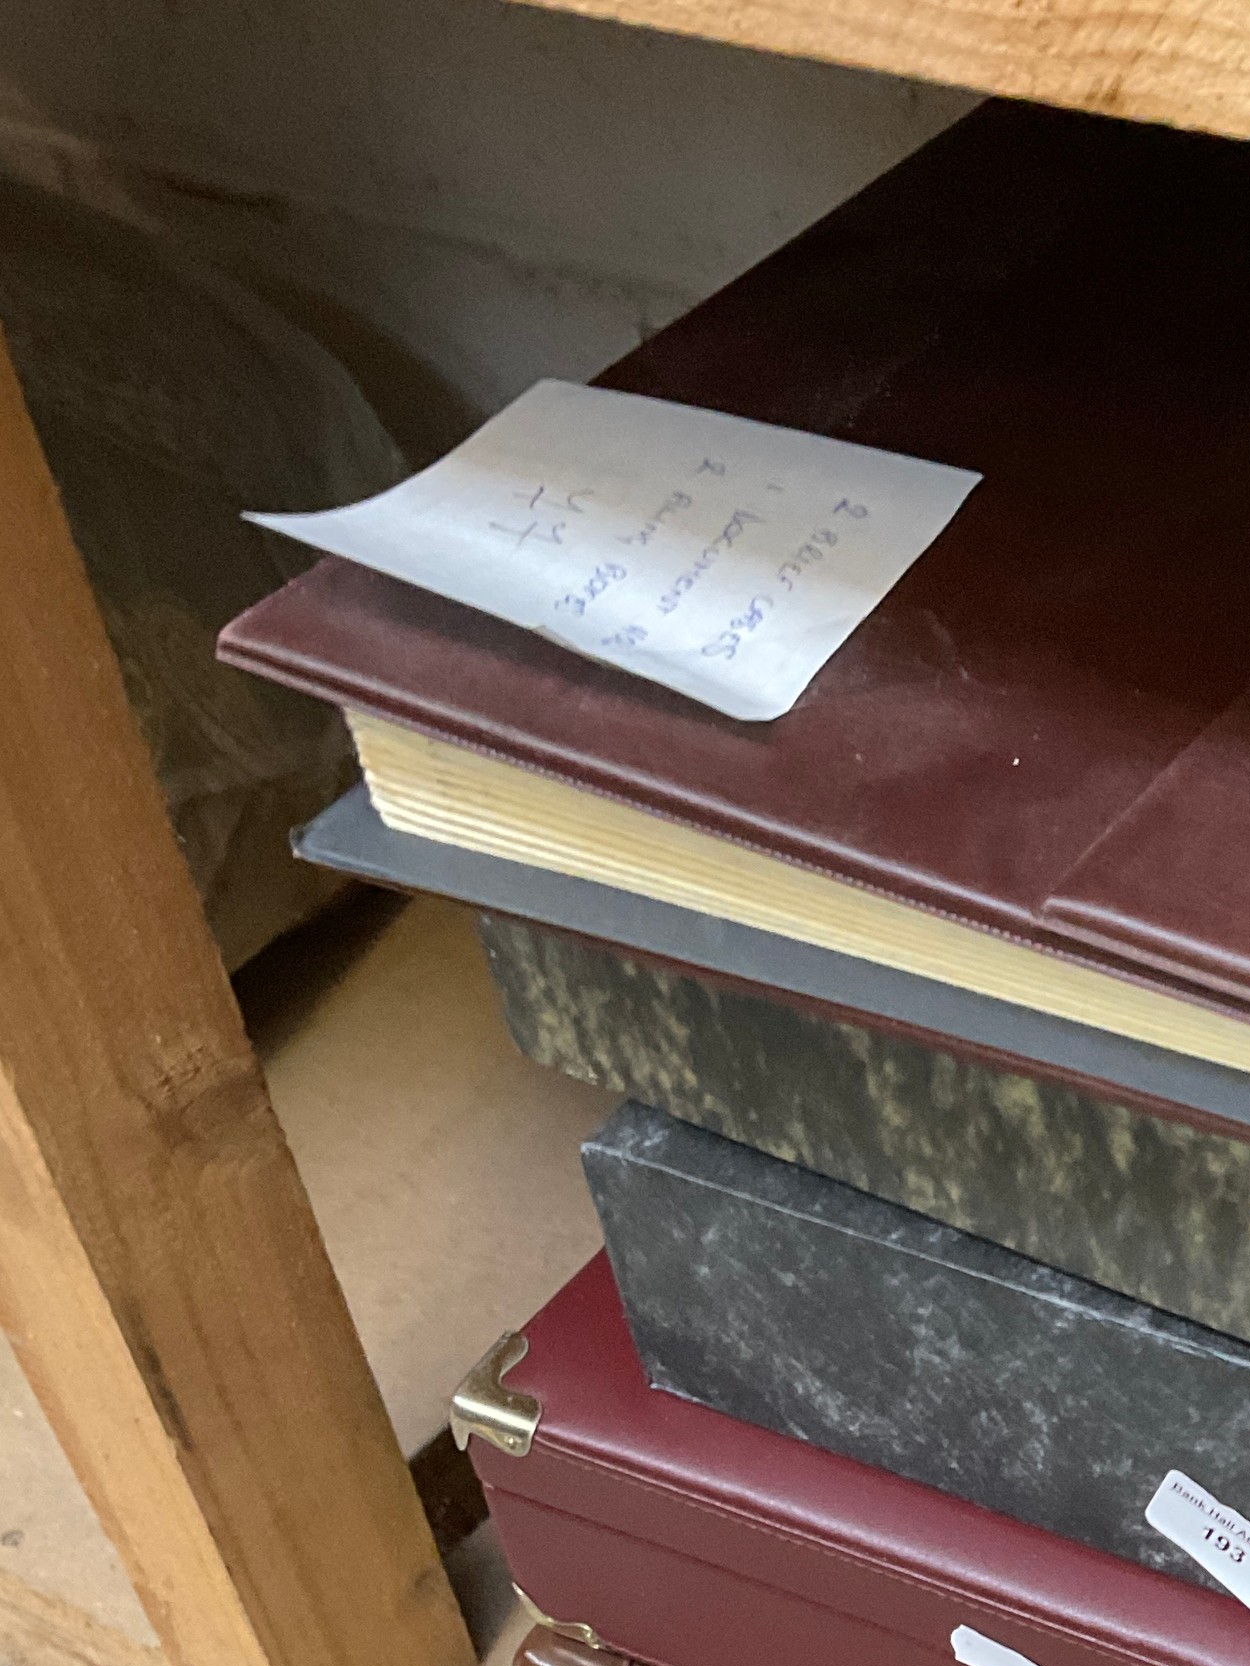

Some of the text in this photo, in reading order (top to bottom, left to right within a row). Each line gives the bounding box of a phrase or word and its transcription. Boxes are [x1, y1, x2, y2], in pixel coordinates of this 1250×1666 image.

[1170, 1481, 1206, 1513] Bank
[1208, 1507, 1236, 1531] Hall
[1203, 1527, 1247, 1564] 193
